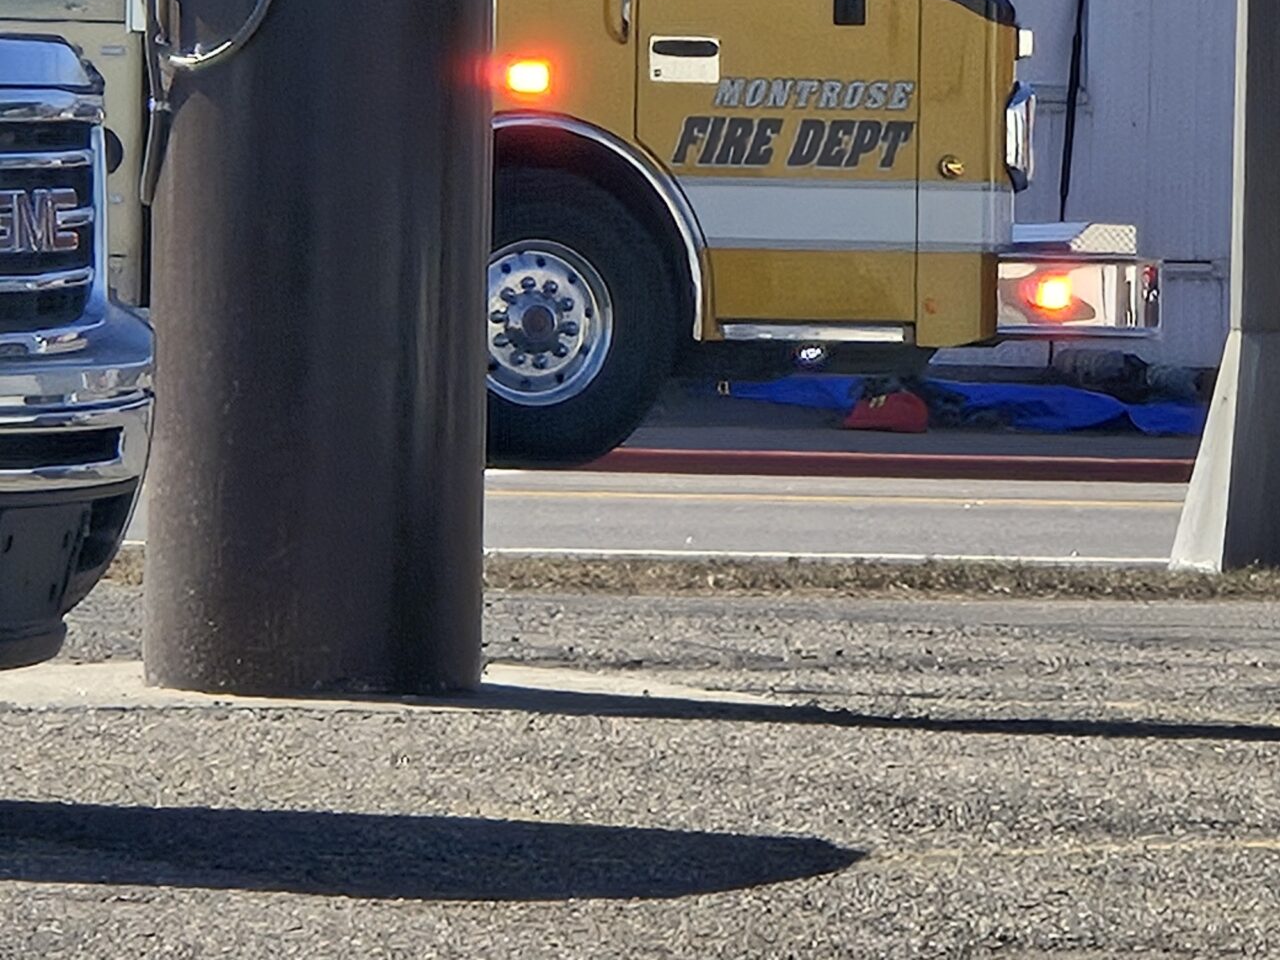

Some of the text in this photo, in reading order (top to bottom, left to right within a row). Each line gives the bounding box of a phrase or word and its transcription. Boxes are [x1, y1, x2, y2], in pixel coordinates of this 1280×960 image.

[713, 77, 916, 110] MONTROSE
[672, 116, 916, 171] FIRE DEPT
